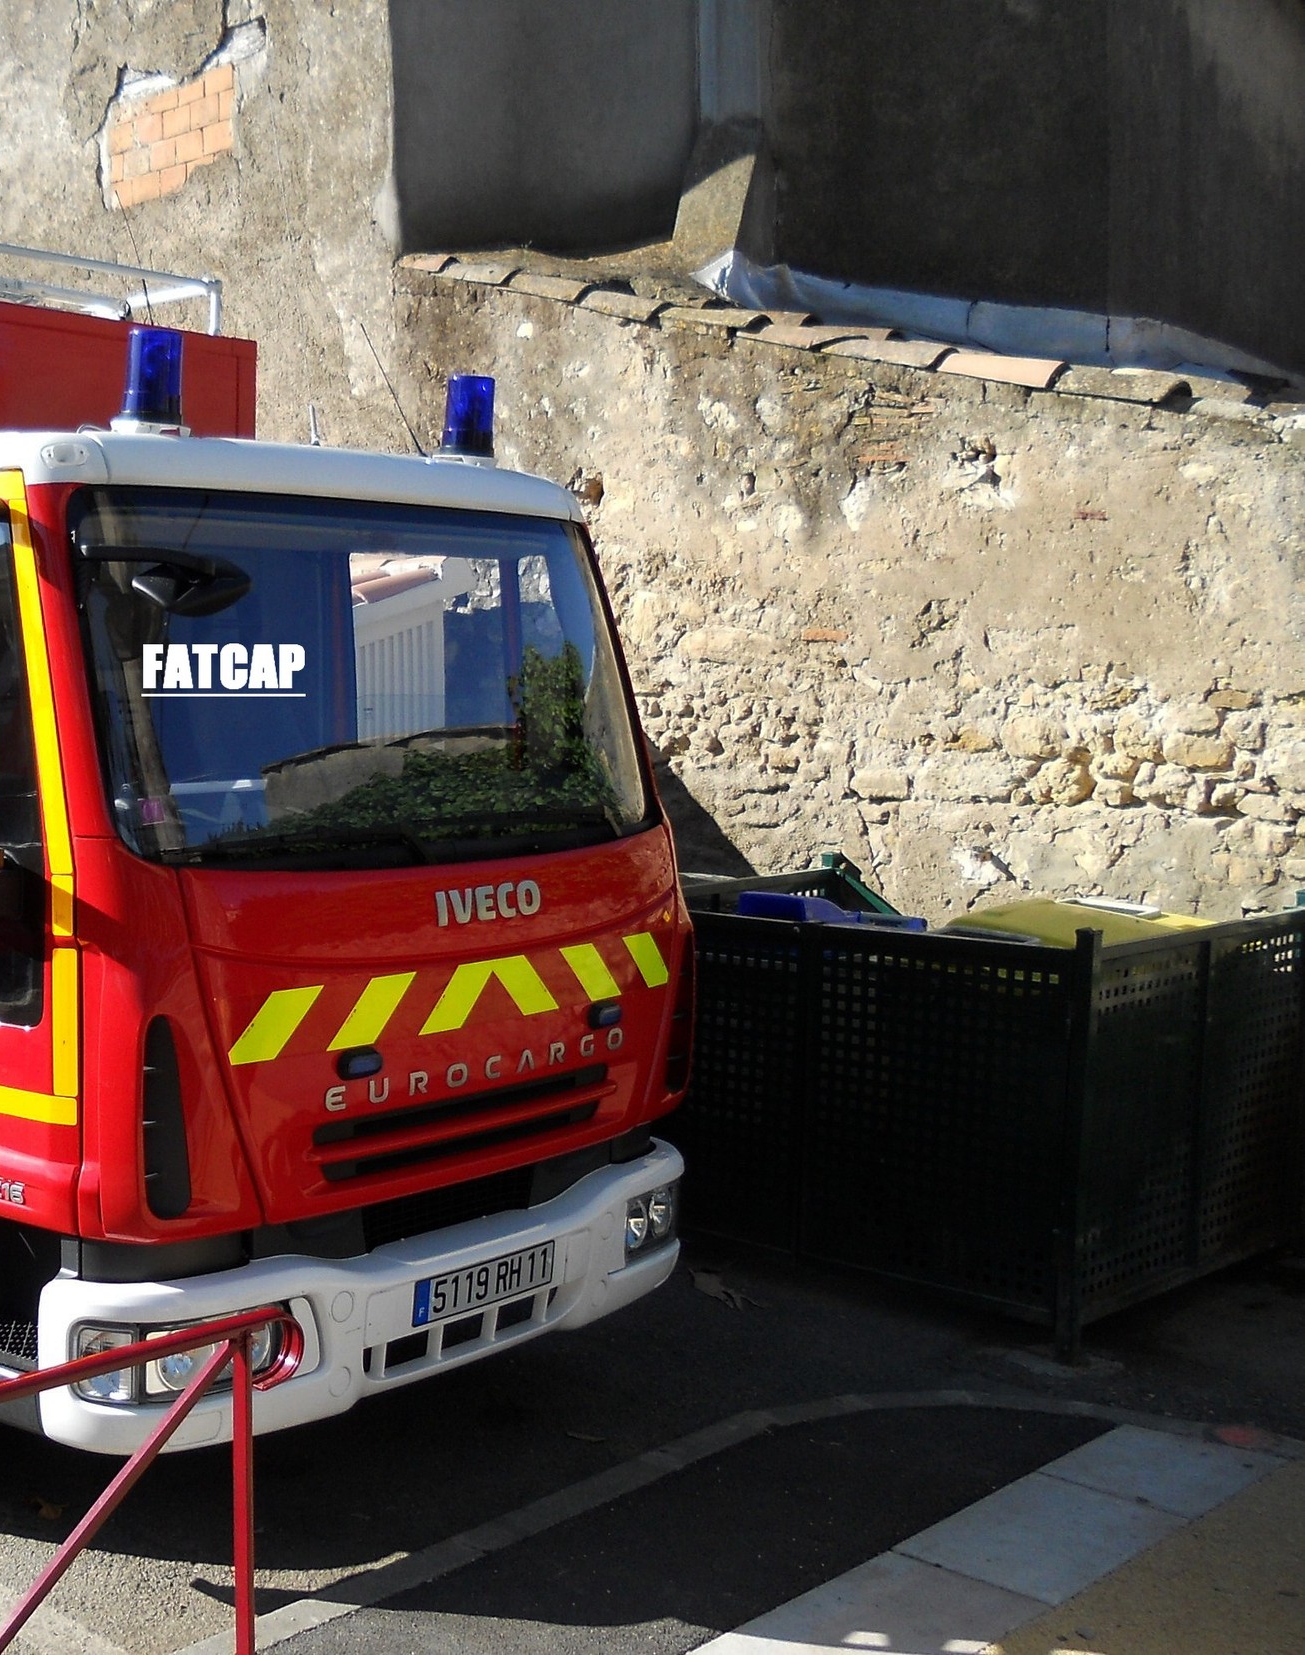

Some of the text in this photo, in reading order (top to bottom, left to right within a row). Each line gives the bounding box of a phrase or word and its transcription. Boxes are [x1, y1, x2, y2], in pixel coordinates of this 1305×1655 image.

[435, 879, 542, 927] IVECO
[324, 1027, 625, 1112] EUROCARGO
[432, 1266, 490, 1314] 5119
[495, 1255, 522, 1295] RH
[528, 1247, 548, 1283] 11
